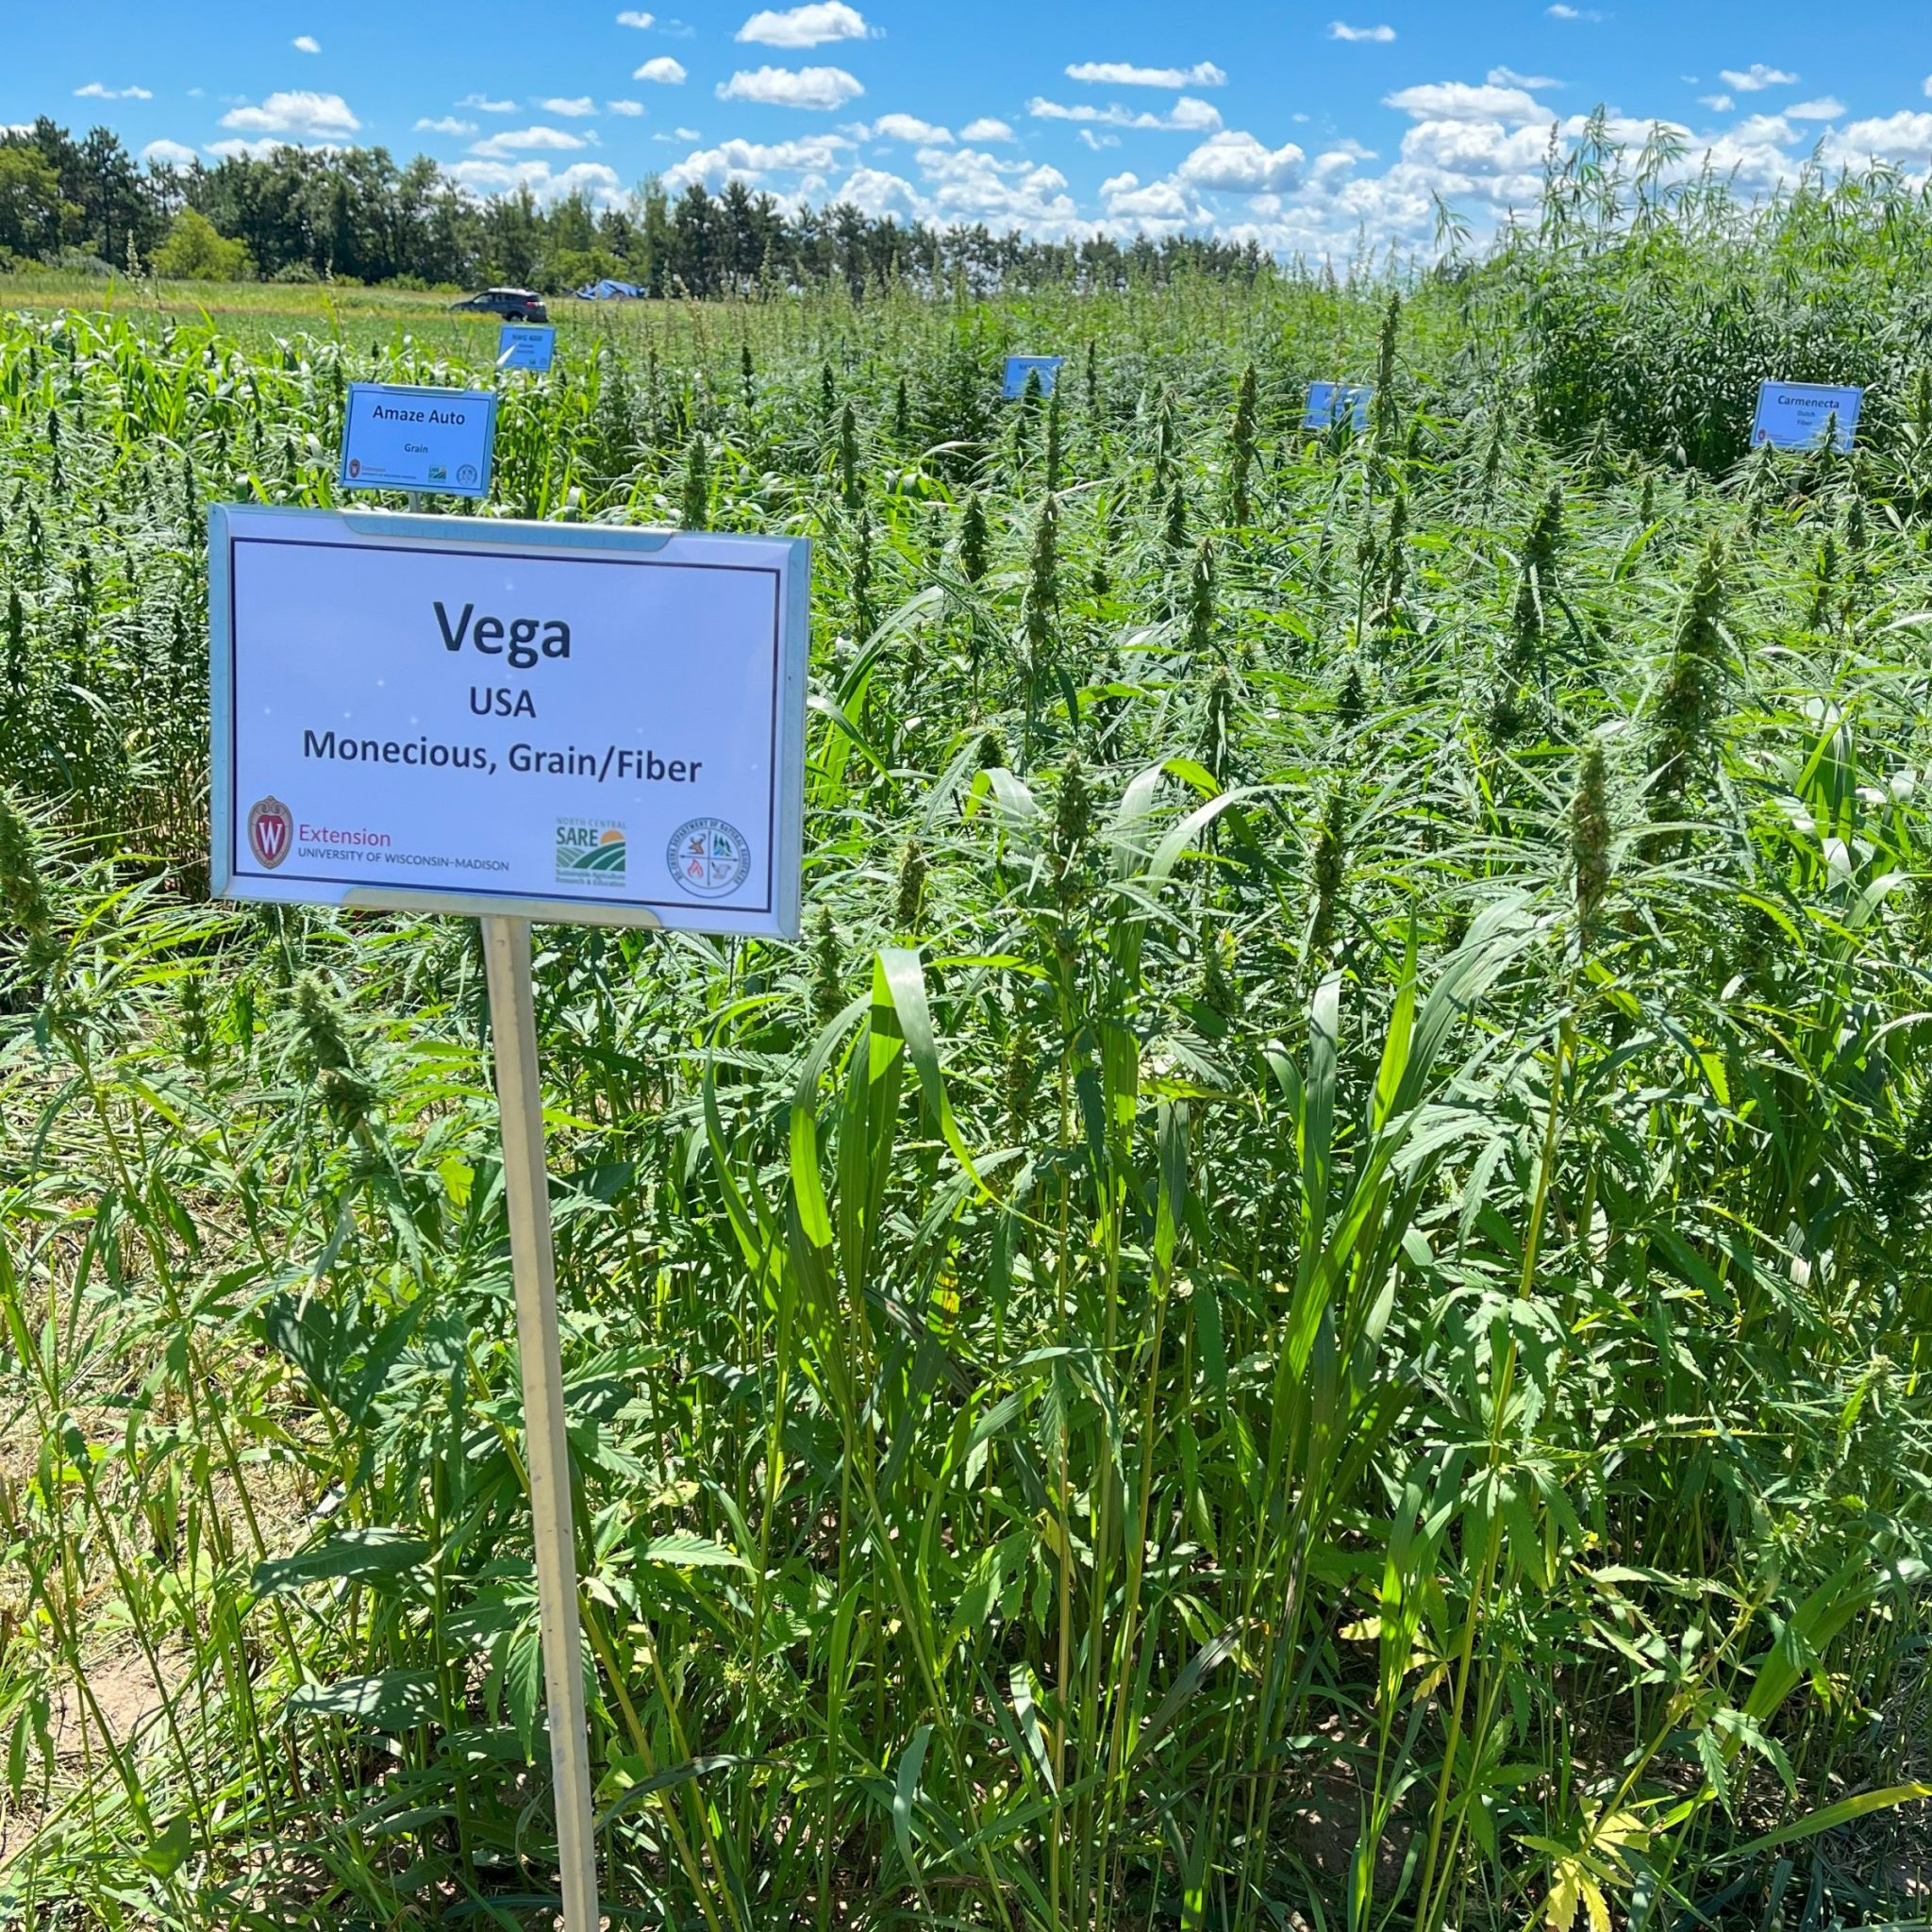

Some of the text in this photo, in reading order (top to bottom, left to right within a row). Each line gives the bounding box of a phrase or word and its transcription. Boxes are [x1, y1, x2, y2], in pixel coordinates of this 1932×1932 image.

[1777, 395, 1840, 408] Carmenecta
[373, 405, 465, 425] Amaze Auto
[404, 443, 428, 454] Grain
[433, 601, 570, 669] Vega
[471, 687, 536, 718] USA
[304, 729, 702, 783] Monecious, Grain/Fiber
[557, 817, 626, 829] NORTH CENTRAL
[258, 821, 282, 855] W
[299, 824, 391, 847] Extension
[557, 826, 598, 847] SARE
[298, 847, 364, 861] UNIVERSITY
[366, 852, 381, 862] OF
